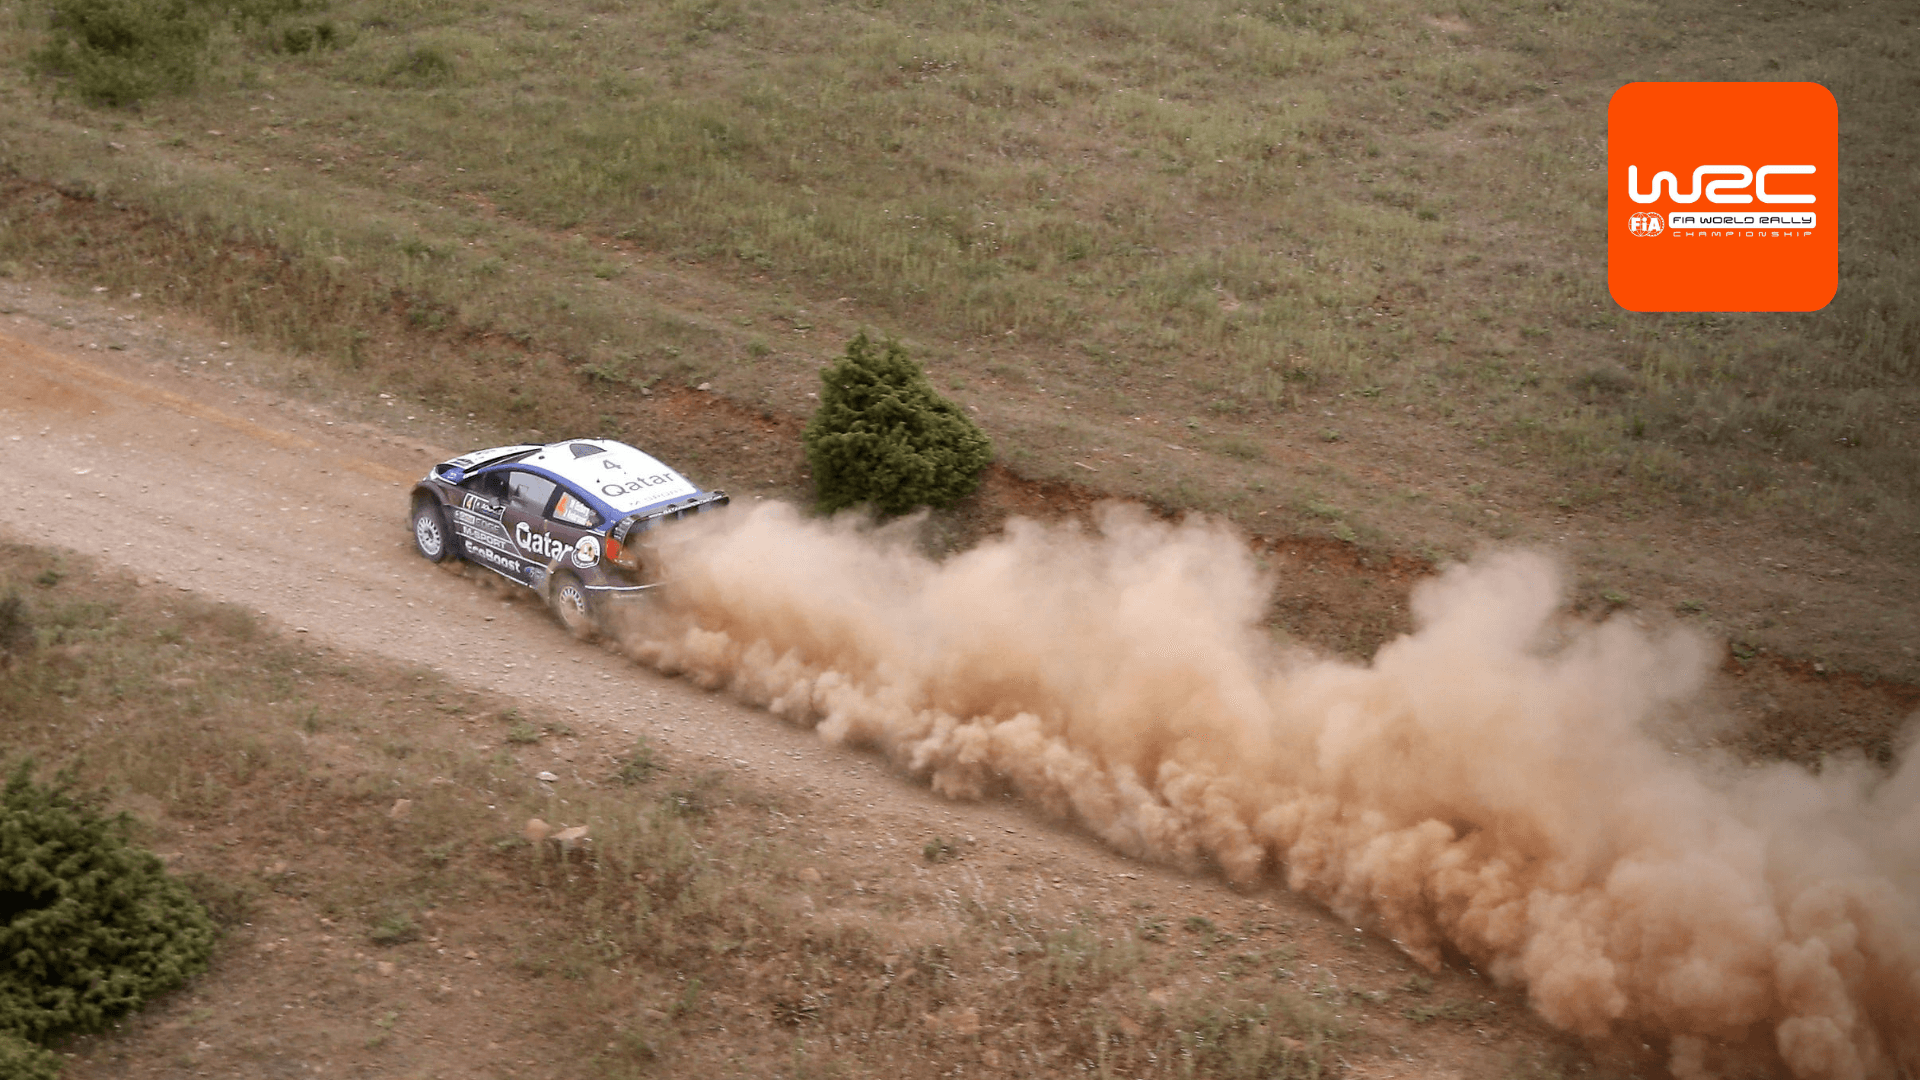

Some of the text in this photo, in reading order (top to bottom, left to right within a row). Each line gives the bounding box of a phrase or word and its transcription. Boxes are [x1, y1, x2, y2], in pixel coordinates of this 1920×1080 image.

[602, 459, 622, 470] 4
[601, 472, 674, 497] Qatar
[466, 496, 474, 510] 4
[515, 521, 574, 562] Qatar
[465, 539, 521, 573] EcoBoost
